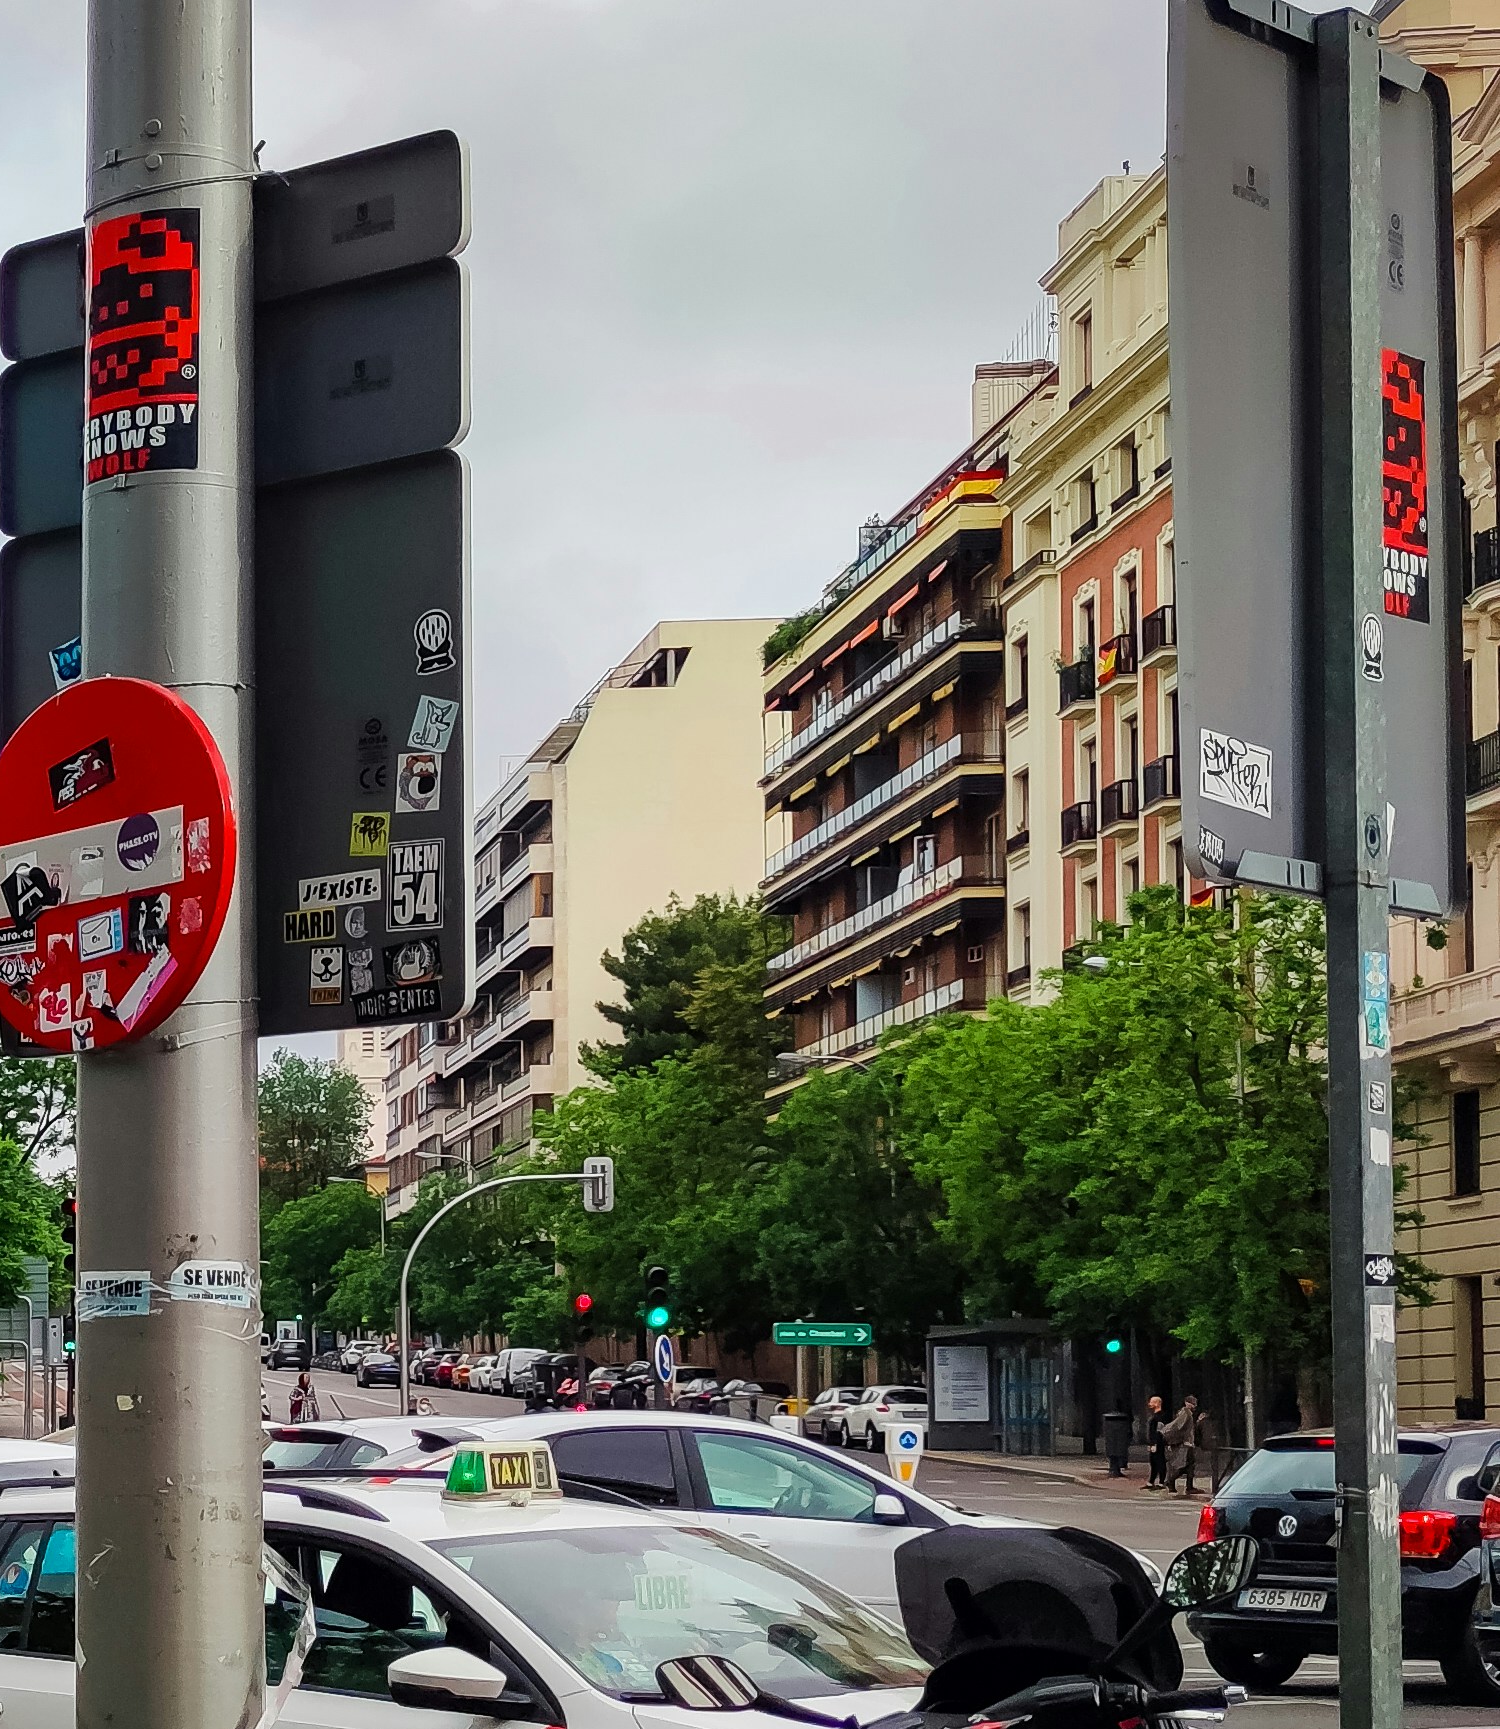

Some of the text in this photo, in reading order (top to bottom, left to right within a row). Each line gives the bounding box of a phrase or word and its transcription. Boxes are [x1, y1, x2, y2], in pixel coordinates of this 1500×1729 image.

[88, 448, 151, 481] WOLF
[1382, 546, 1428, 578] YBODY
[1383, 568, 1416, 597] OWS
[1385, 591, 1410, 617] OLF
[393, 844, 439, 874] TAEM
[393, 872, 438, 925] 54
[285, 909, 336, 942] HARD
[311, 987, 341, 1002] THINK
[98, 1279, 143, 1298] VENDE
[183, 1268, 247, 1288] SE VENDE
[491, 1456, 530, 1486] TAXI
[638, 1574, 691, 1611] LIBRE
[1248, 1590, 1323, 1609] 6385 HDR
